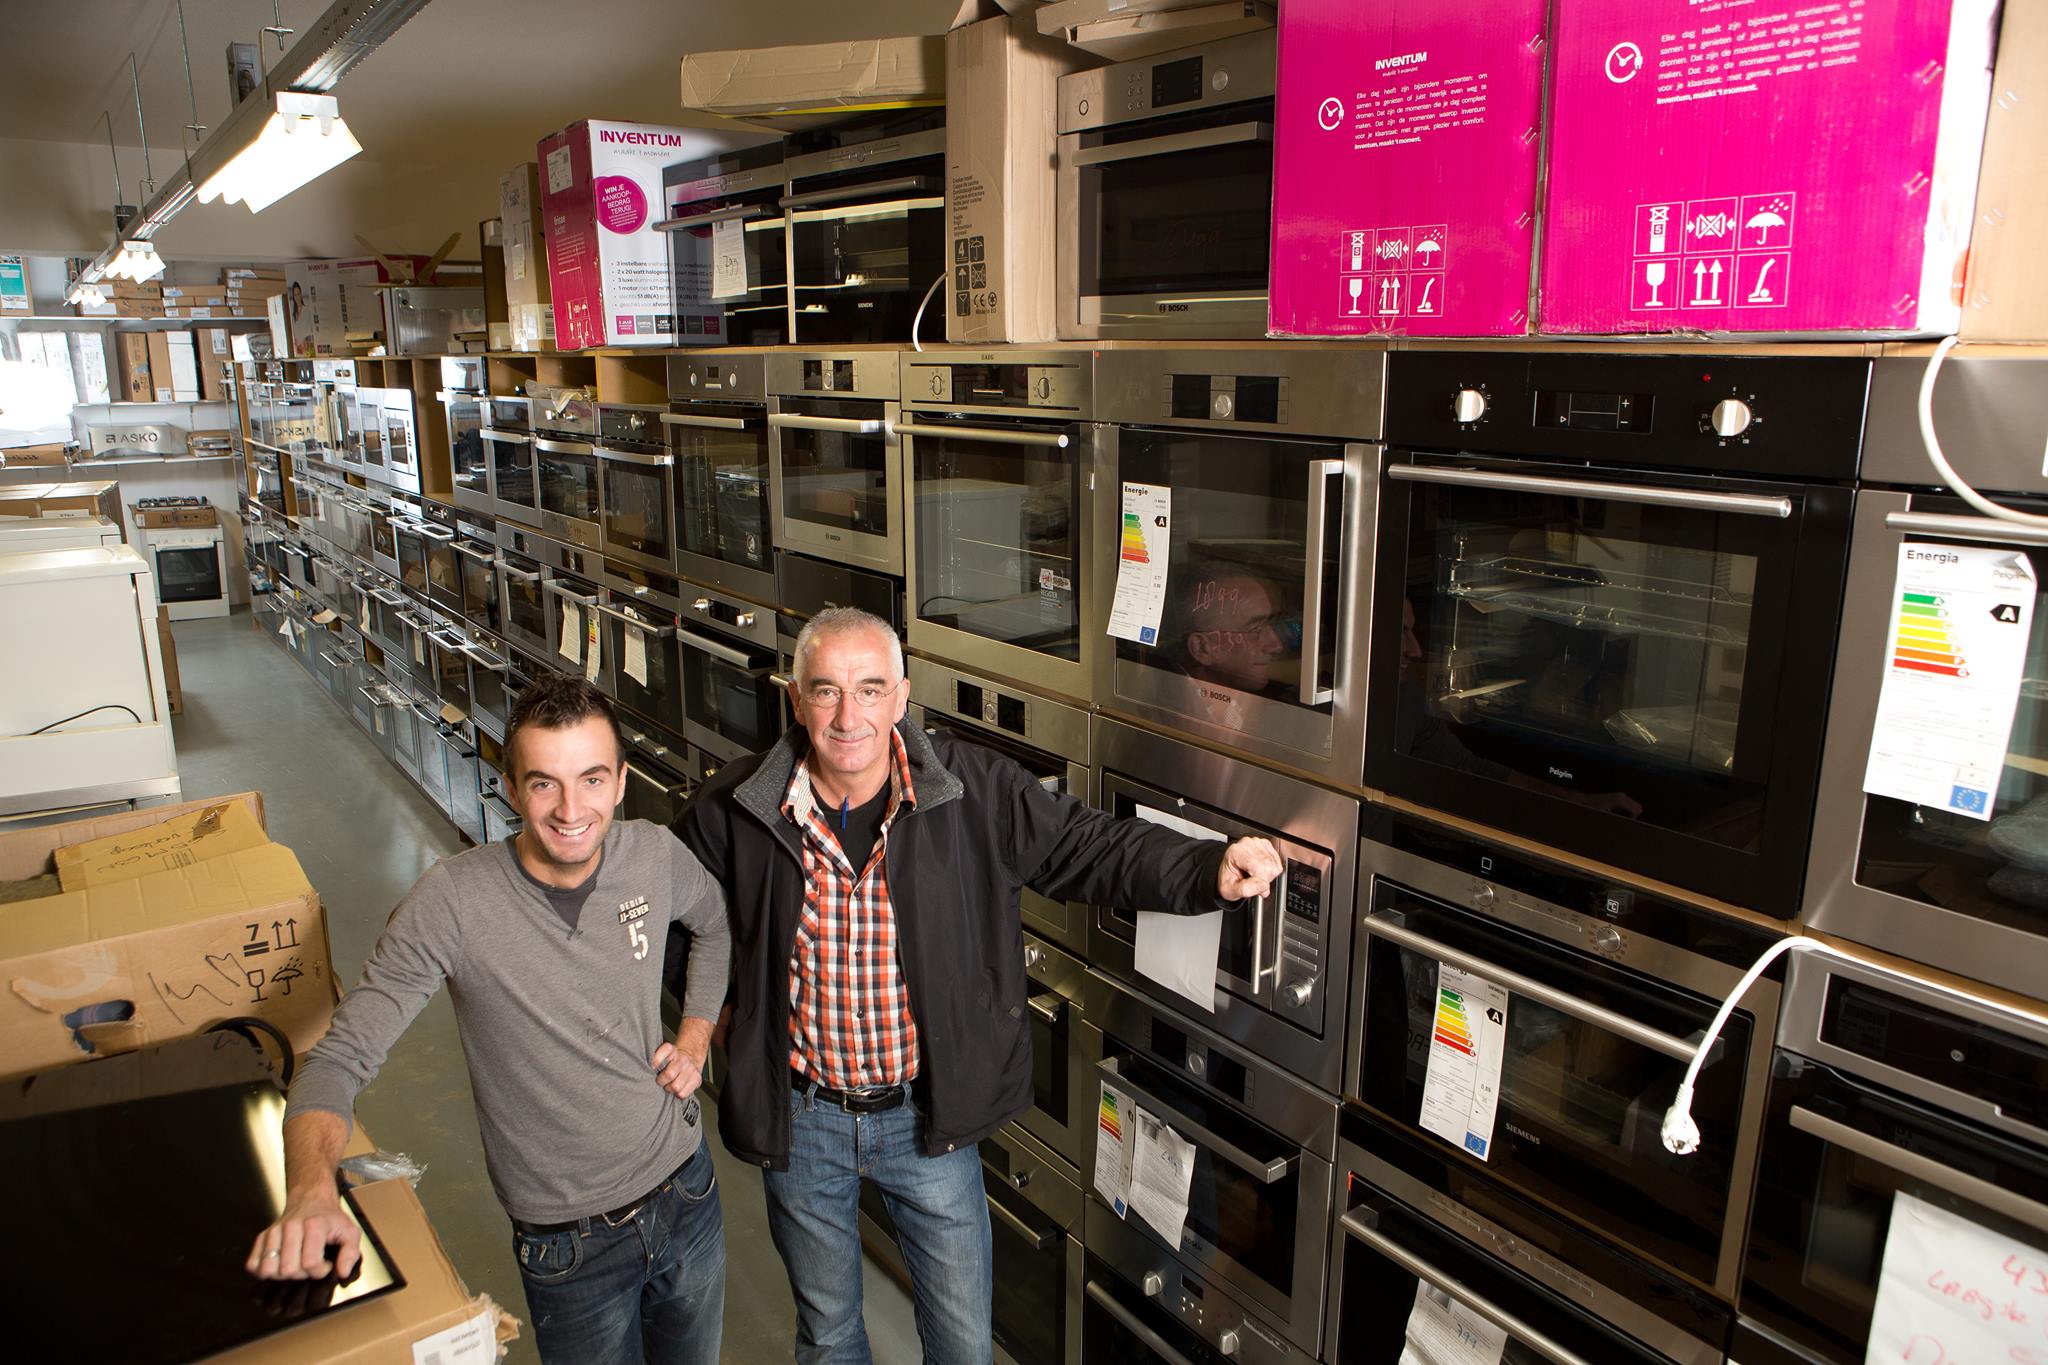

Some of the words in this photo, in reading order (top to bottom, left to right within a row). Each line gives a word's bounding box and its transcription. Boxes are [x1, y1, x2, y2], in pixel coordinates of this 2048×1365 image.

[1661, 34, 1676, 43] Elke
[1682, 30, 1696, 40] dag
[1702, 26, 1721, 35] heeft
[1728, 22, 1741, 31] zijn
[1748, 14, 1788, 28] bijzondere
[1795, 4, 1841, 18] momenten:
[1848, 0, 1865, 9] om
[1660, 45, 1683, 55] samen
[1701, 37, 1732, 49] genieten
[1736, 33, 1746, 42] of
[1750, 30, 1767, 41] juist
[1772, 24, 1799, 36] heerlijk
[1804, 20, 1825, 30] even
[1830, 15, 1848, 26] weg
[1853, 13, 1863, 22] te
[1659, 57, 1687, 68] dromen.
[1690, 55, 1703, 63] Dat
[1706, 51, 1719, 61] zijn
[1720, 49, 1731, 57] de
[1734, 42, 1775, 55] momenten
[1777, 38, 1790, 48] die
[1791, 37, 1801, 48] je
[1803, 34, 1819, 44] dag
[1821, 27, 1861, 41] compleet
[1375, 52, 1428, 70] INVENTUM
[1658, 71, 1683, 80] maken.
[1687, 67, 1701, 76] Dat
[1706, 64, 1718, 74] zijn
[1723, 61, 1734, 70] de
[1739, 54, 1780, 67] momenten
[1785, 49, 1815, 61] waarop
[1821, 41, 1860, 54] Inventum
[1658, 83, 1674, 92] voor
[1676, 82, 1684, 92] je
[1687, 75, 1722, 89] klaarstaat:
[1727, 72, 1742, 82] met
[1745, 69, 1772, 80] gemak,
[1776, 64, 1803, 76] plezier
[1807, 61, 1818, 70] en
[1822, 56, 1858, 68] comfort.
[1414, 81, 1439, 90] bijzondere
[1444, 75, 1473, 85] momenten:
[1356, 102, 1372, 110] samen
[1384, 98, 1404, 107] genieten
[1415, 93, 1426, 102] juist
[1429, 90, 1447, 98] heerlijk
[1656, 93, 1692, 105] Inventum,
[1693, 91, 1716, 100] maakt
[1723, 84, 1758, 95] moment.
[1405, 104, 1432, 112] momenten
[1461, 95, 1486, 105] compleet
[1409, 114, 1435, 122] momenten
[1439, 110, 1458, 119] waarop
[1461, 106, 1486, 115] Inventum
[1375, 128, 1399, 137] klaarstaat:
[1413, 124, 1430, 133] gemak,
[1433, 121, 1450, 130] plezier
[1462, 117, 1485, 126] comfort.
[600, 130, 682, 147] INVENTUM
[1354, 141, 1379, 150] Inventum,
[1379, 139, 1395, 147] maakt
[602, 190, 631, 202] AANKOOP-
[605, 186, 617, 194] WIN
[608, 198, 630, 208] BEDRAG
[611, 205, 631, 215] TERUG!
[1655, 225, 1662, 234] 5
[958, 242, 965, 257] 4
[1168, 304, 1188, 312] BOSCH
[120, 432, 158, 443] ASKO
[1124, 485, 1148, 496] Energie
[1159, 517, 1165, 526] A
[1906, 550, 1959, 564] Energia
[2000, 607, 2016, 622] A
[1210, 691, 1231, 703] BOSCH
[246, 923, 260, 942] 7
[628, 920, 648, 960] 5
[1492, 1011, 1500, 1022] A
[1505, 1122, 1541, 1145] SIEMENS
